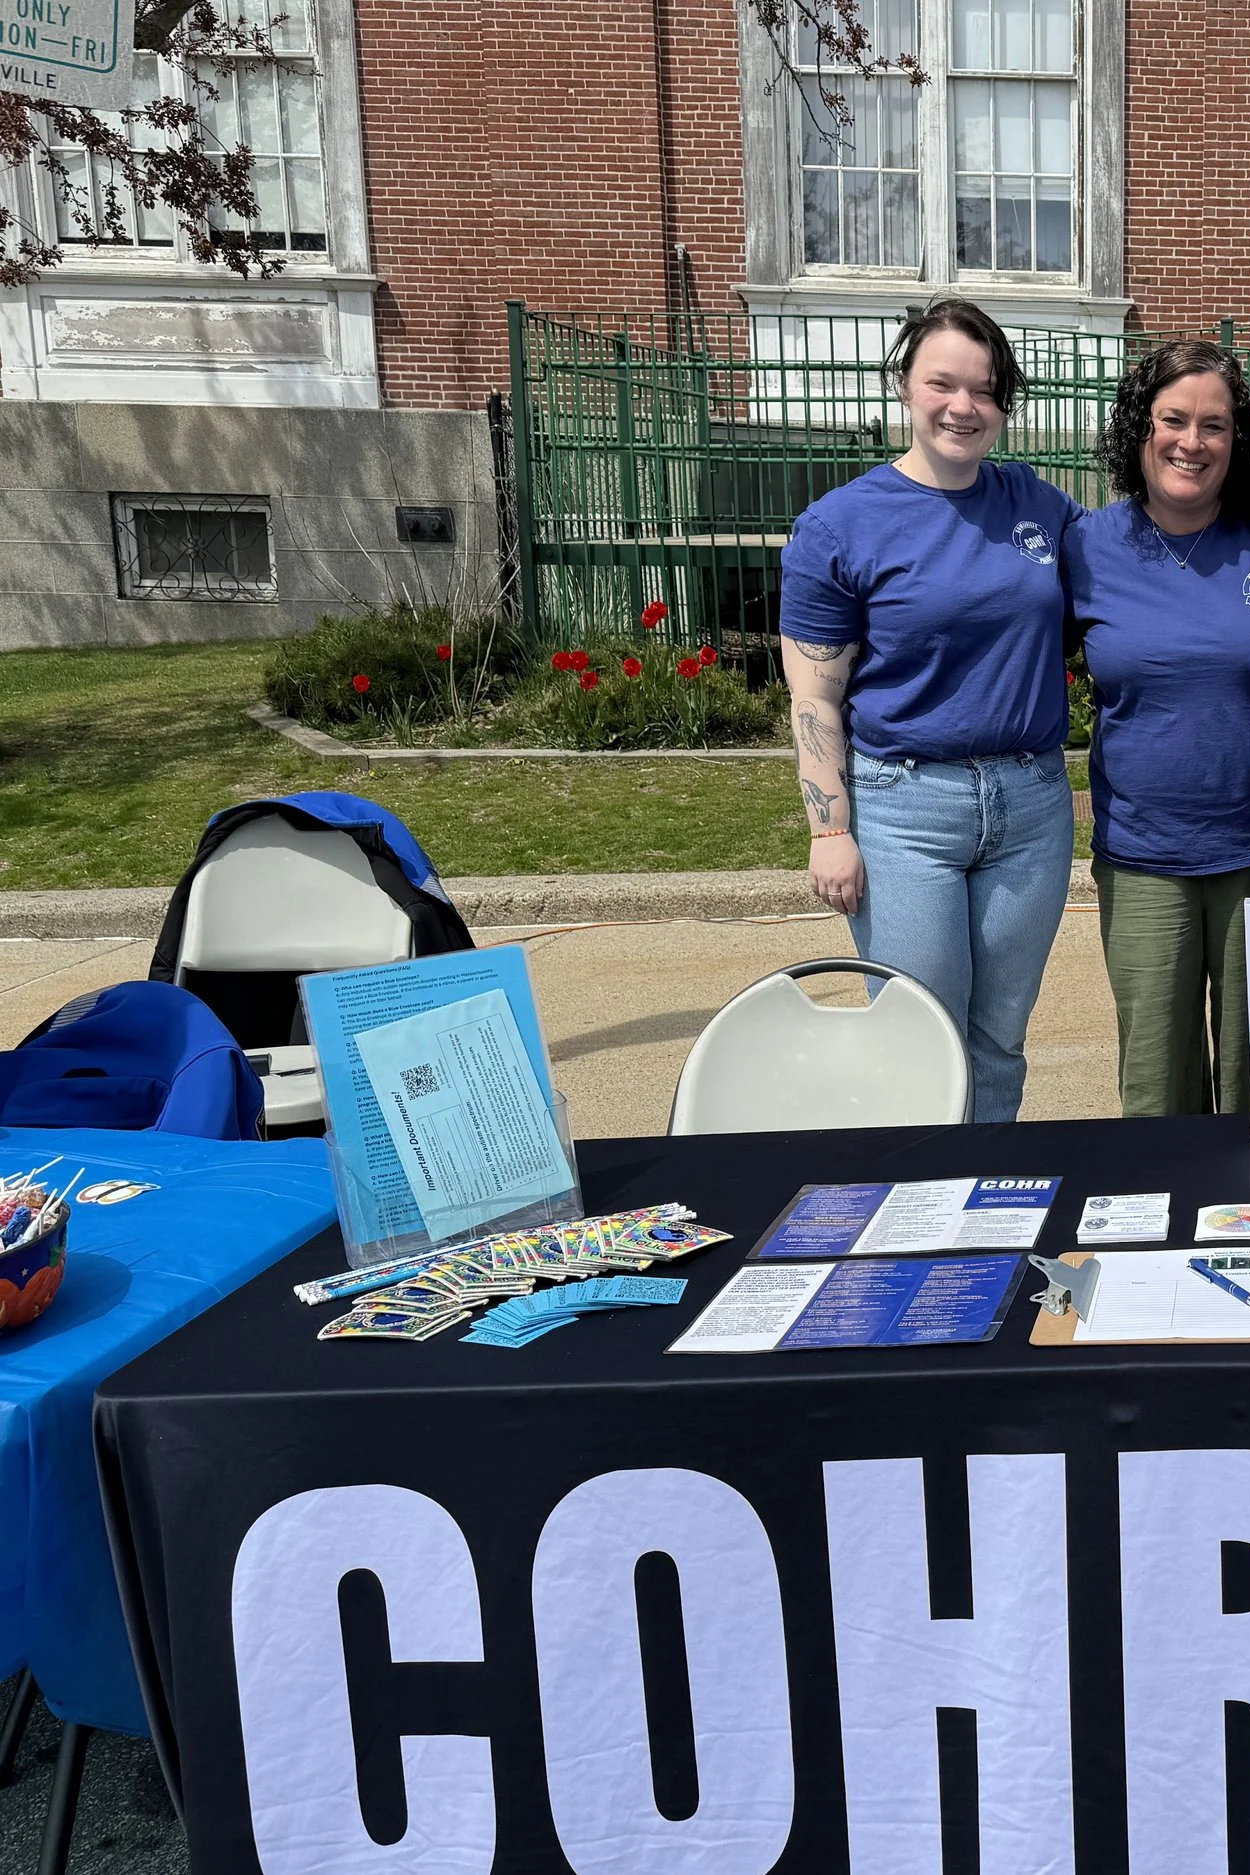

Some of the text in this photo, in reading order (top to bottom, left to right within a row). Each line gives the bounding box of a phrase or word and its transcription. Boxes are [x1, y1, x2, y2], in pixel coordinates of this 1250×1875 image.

[17, 0, 70, 27] ONLY
[1, 64, 56, 89] VILLE
[1024, 534, 1046, 550] COHR
[391, 1092, 418, 1145] Documents!
[413, 1146, 436, 1191] Important
[980, 1180, 1052, 1191] COHR
